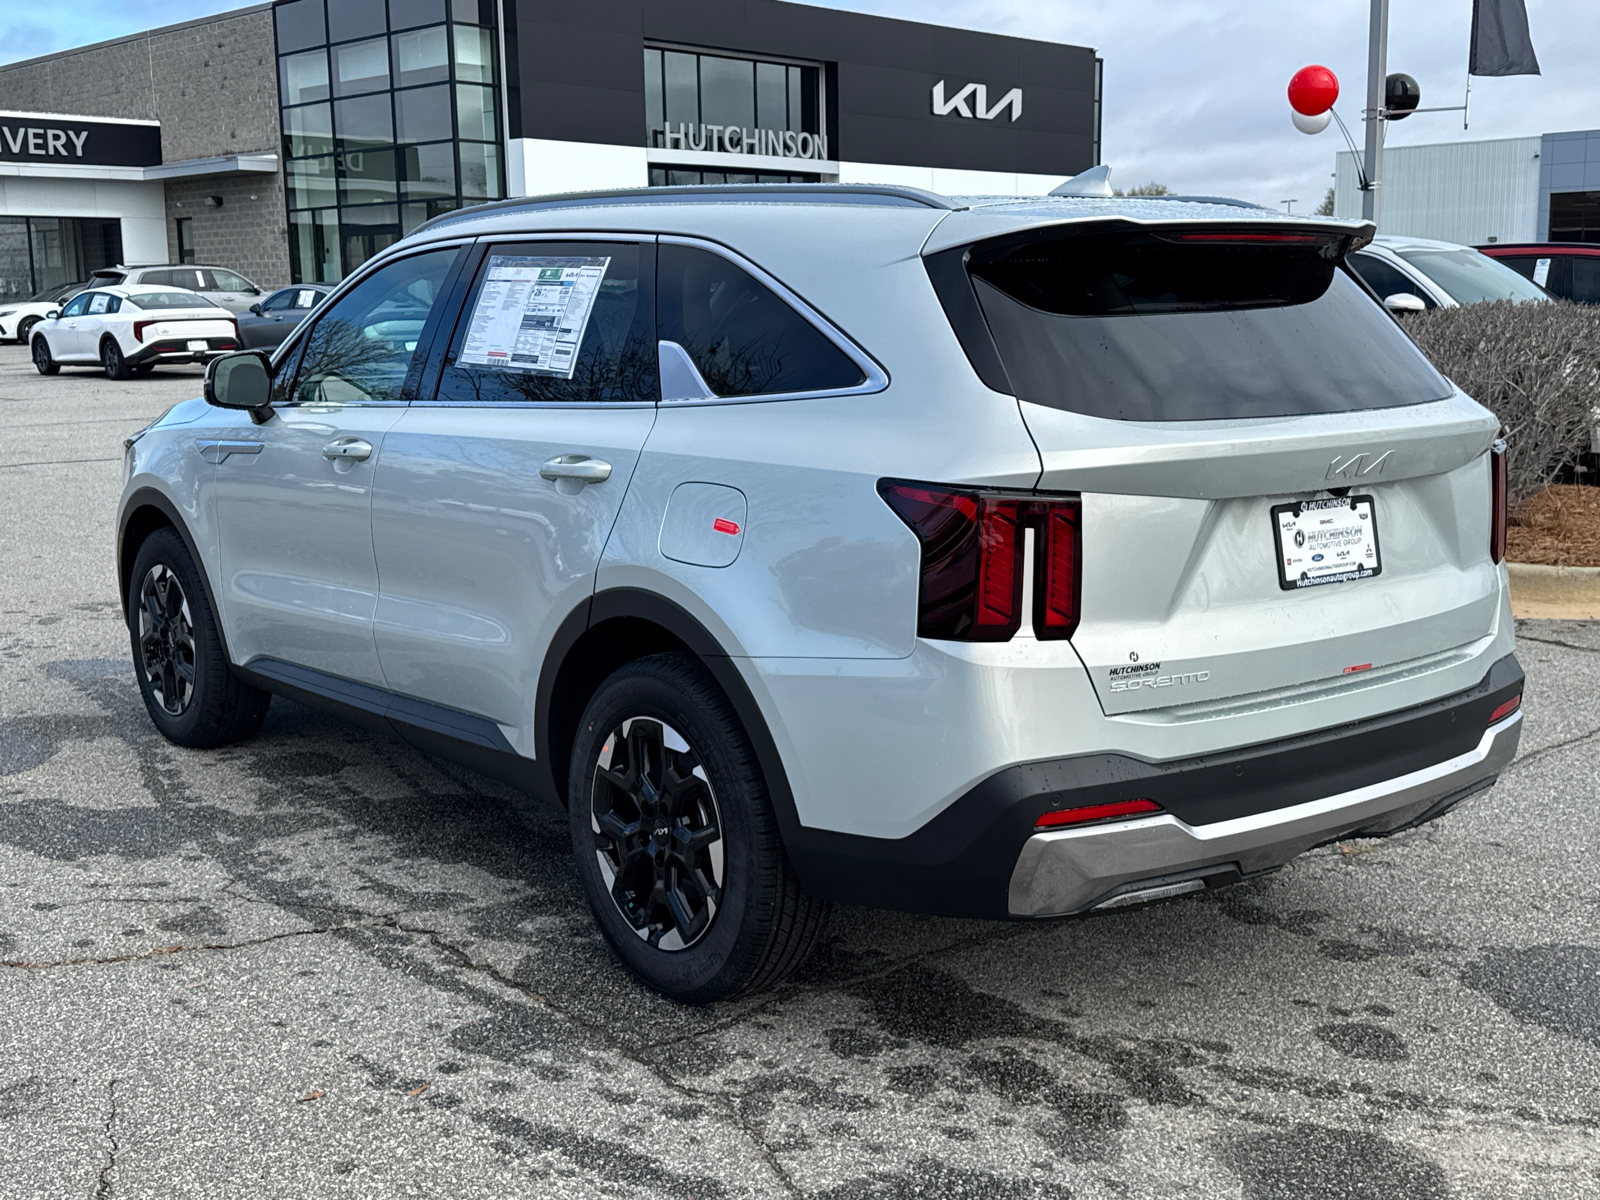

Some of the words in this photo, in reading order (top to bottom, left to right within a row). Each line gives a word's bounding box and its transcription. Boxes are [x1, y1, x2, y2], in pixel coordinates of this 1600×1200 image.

[932, 79, 1023, 123] KIA
[0, 126, 89, 157] VERY
[664, 121, 828, 161] HUTCHINSON
[1309, 497, 1352, 510] HUTCHINSON
[1307, 526, 1363, 544] HUTCHINSON
[1309, 539, 1342, 552] AUTOMOTIVE
[1343, 537, 1362, 548] GROUP
[1296, 569, 1373, 587] Hutchinsonautogroup.com
[1109, 662, 1161, 676] HUTCHINSON
[1110, 672, 1142, 681] AUTOMOTIVE
[1142, 670, 1159, 678] GROUP
[1110, 670, 1210, 692] SORENTO
